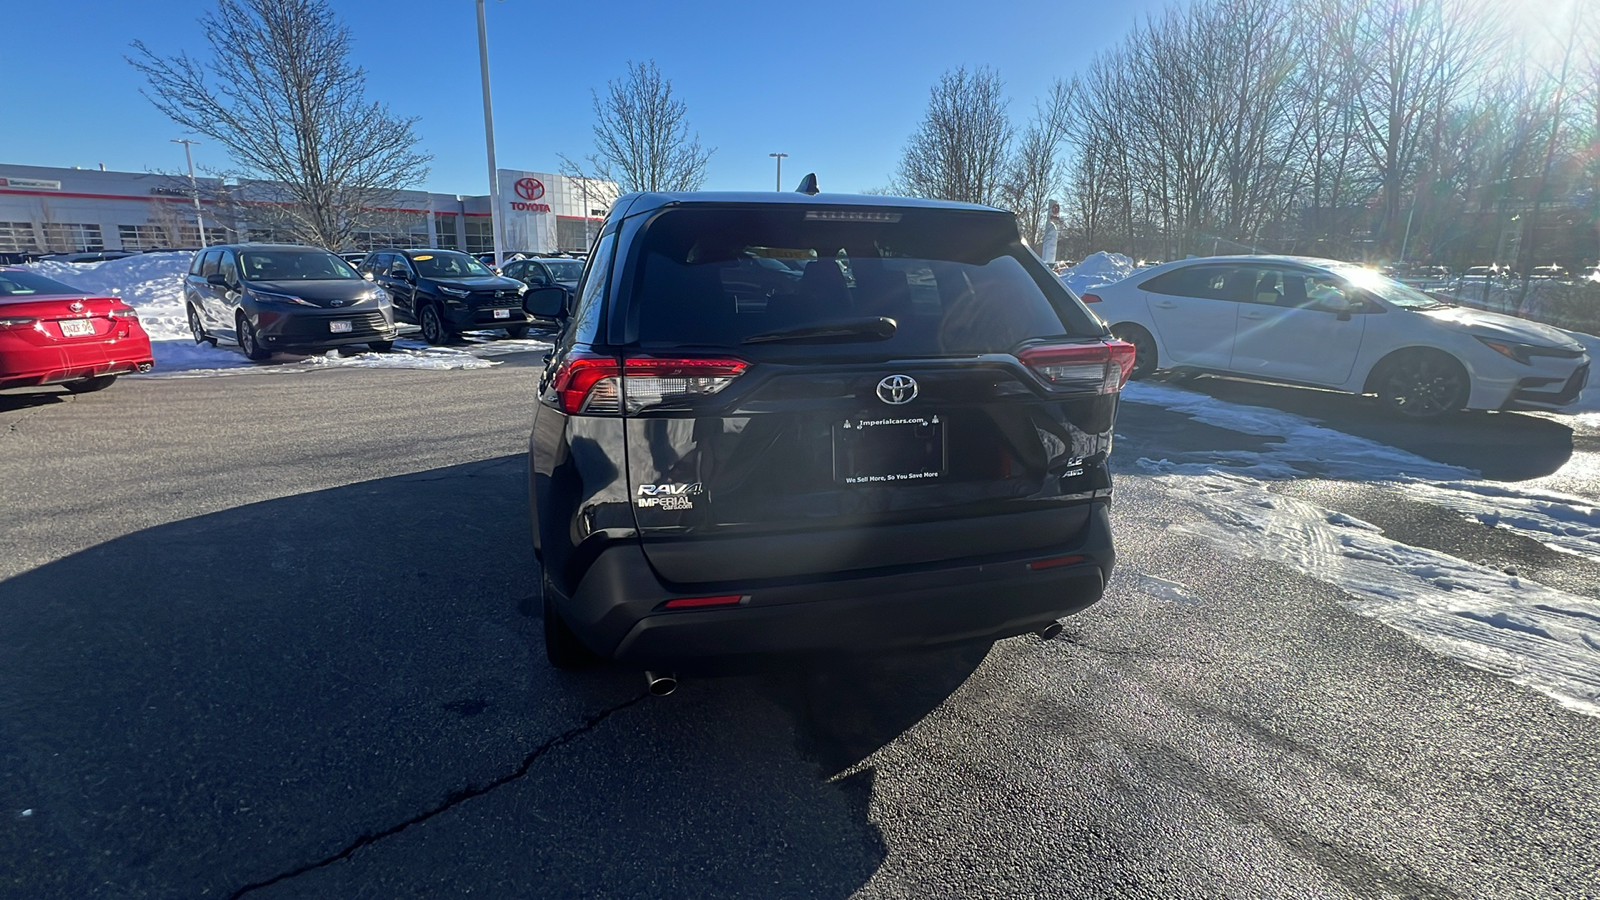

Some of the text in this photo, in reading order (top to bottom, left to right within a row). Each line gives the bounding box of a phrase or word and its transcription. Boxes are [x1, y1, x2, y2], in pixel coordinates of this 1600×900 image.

[509, 201, 551, 212] TOYOTA
[860, 418, 924, 427] Imperialcars.com
[1062, 468, 1083, 478] AWD
[637, 482, 703, 495] RAV4
[638, 496, 692, 507] IMPERIAL
